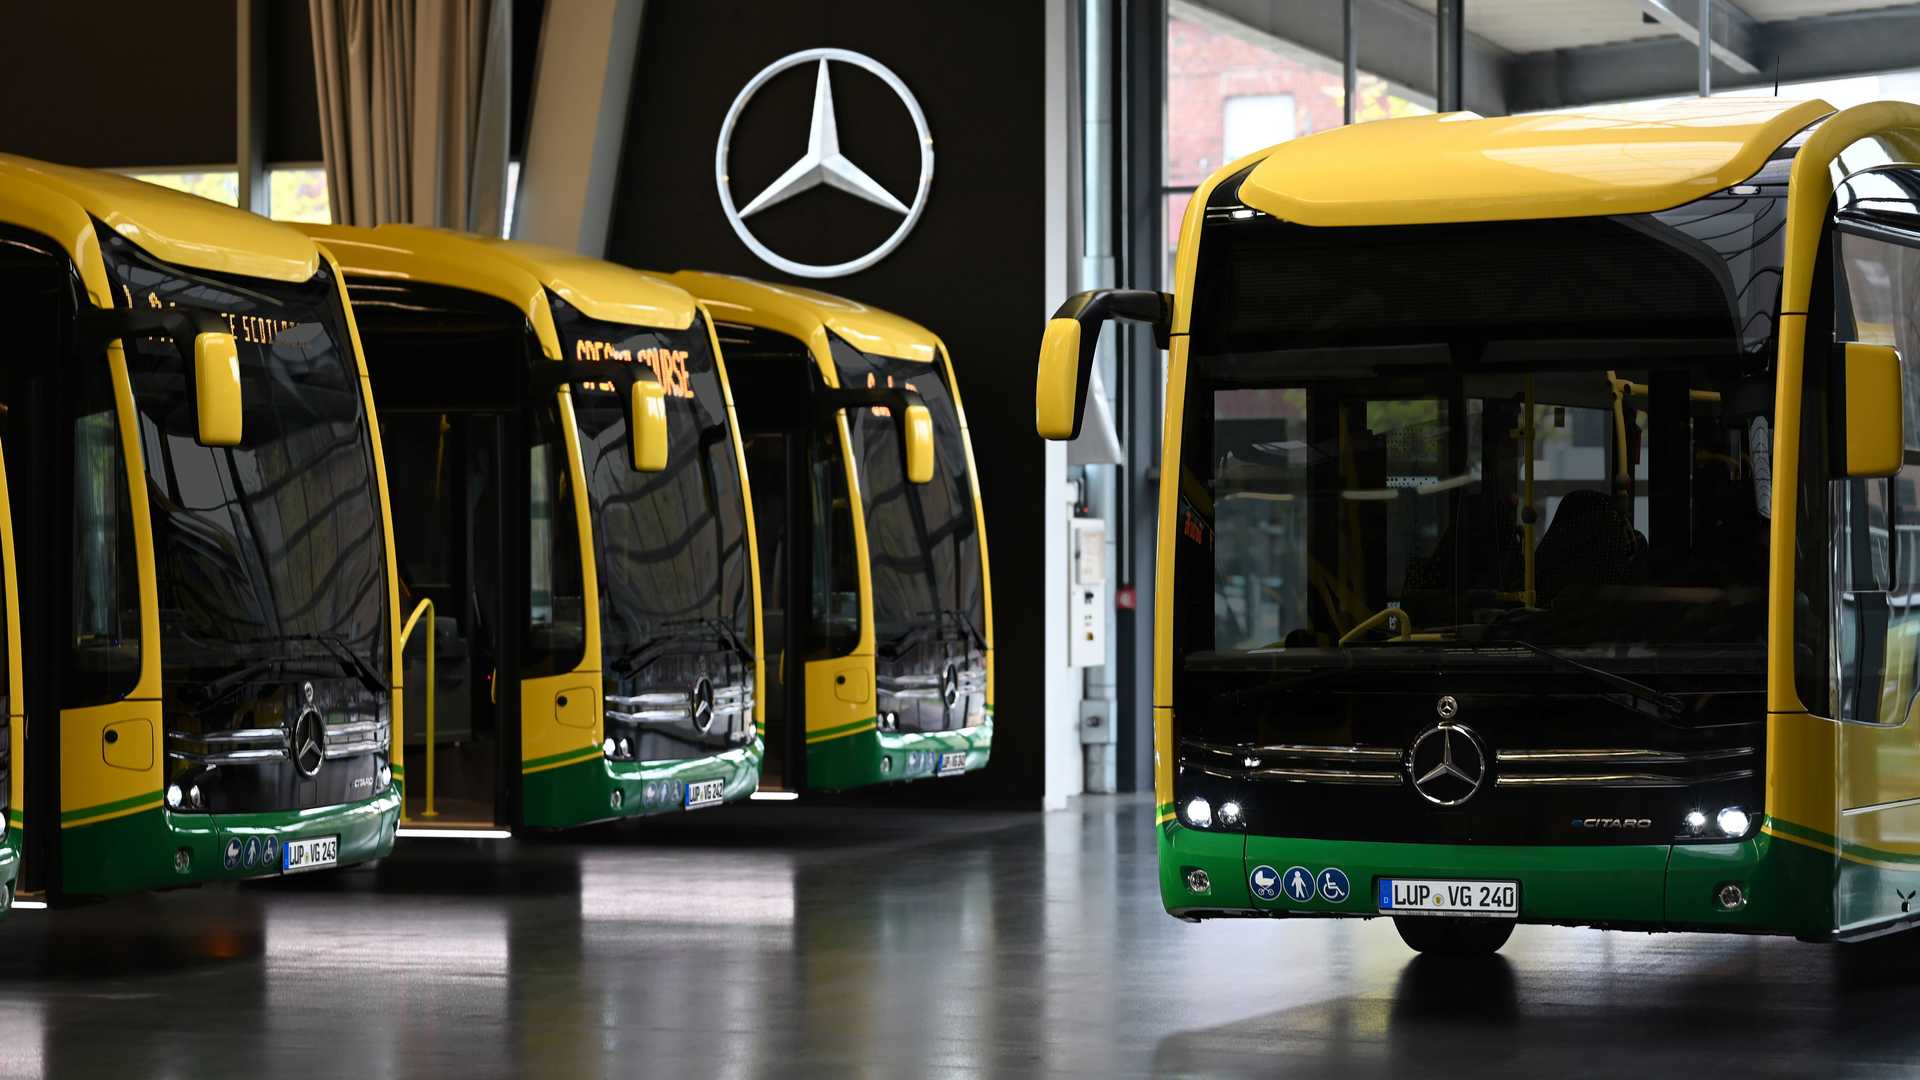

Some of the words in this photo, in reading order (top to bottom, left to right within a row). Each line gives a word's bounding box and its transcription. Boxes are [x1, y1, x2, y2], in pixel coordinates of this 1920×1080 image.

[290, 844, 305, 865] LUP
[310, 843, 320, 863] VG
[322, 841, 336, 861] 243
[1394, 884, 1431, 906] LUP
[1448, 886, 1472, 906] VG
[1479, 886, 1514, 908] 240
